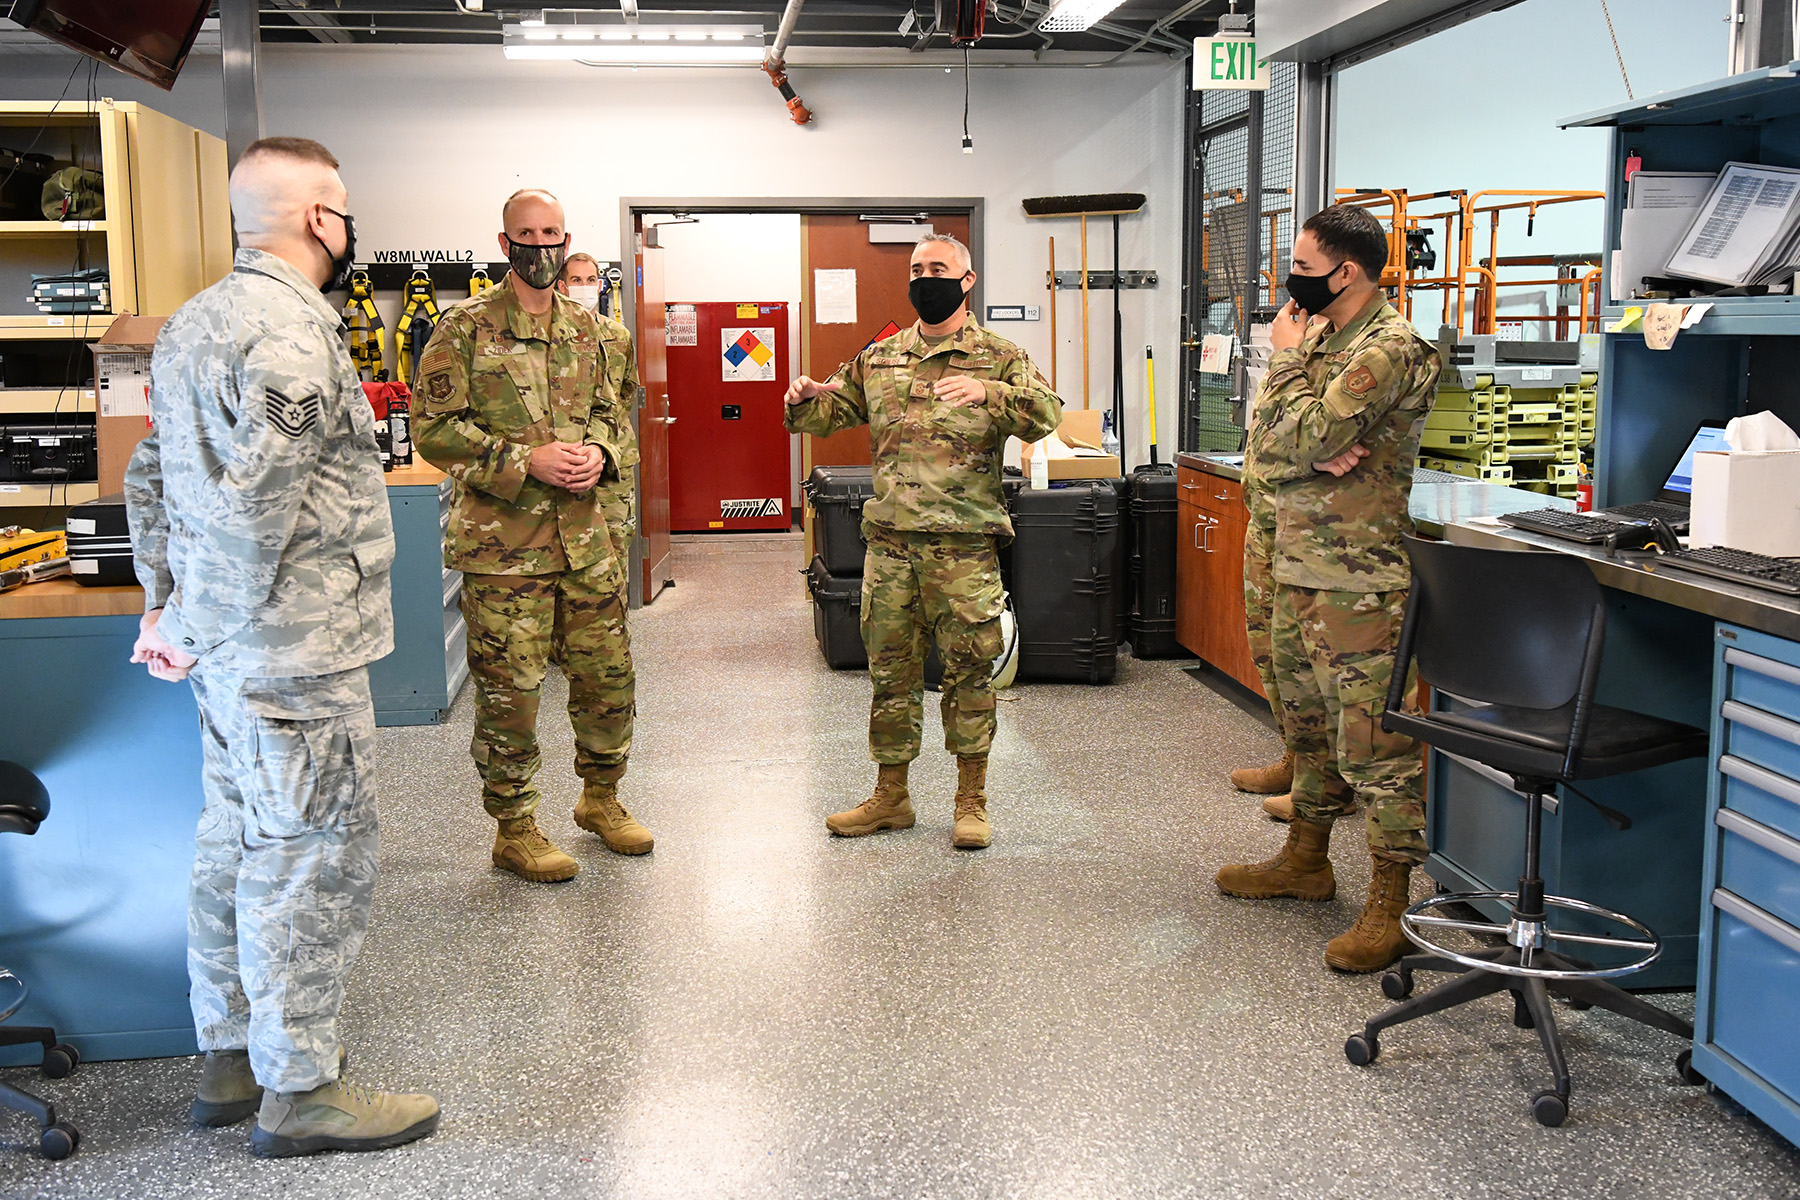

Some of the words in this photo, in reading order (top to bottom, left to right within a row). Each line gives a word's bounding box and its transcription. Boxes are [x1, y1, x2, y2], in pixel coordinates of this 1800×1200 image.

[1211, 42, 1256, 80] EXIT
[374, 250, 473, 262] W8MLWALL2
[745, 338, 751, 346] 3
